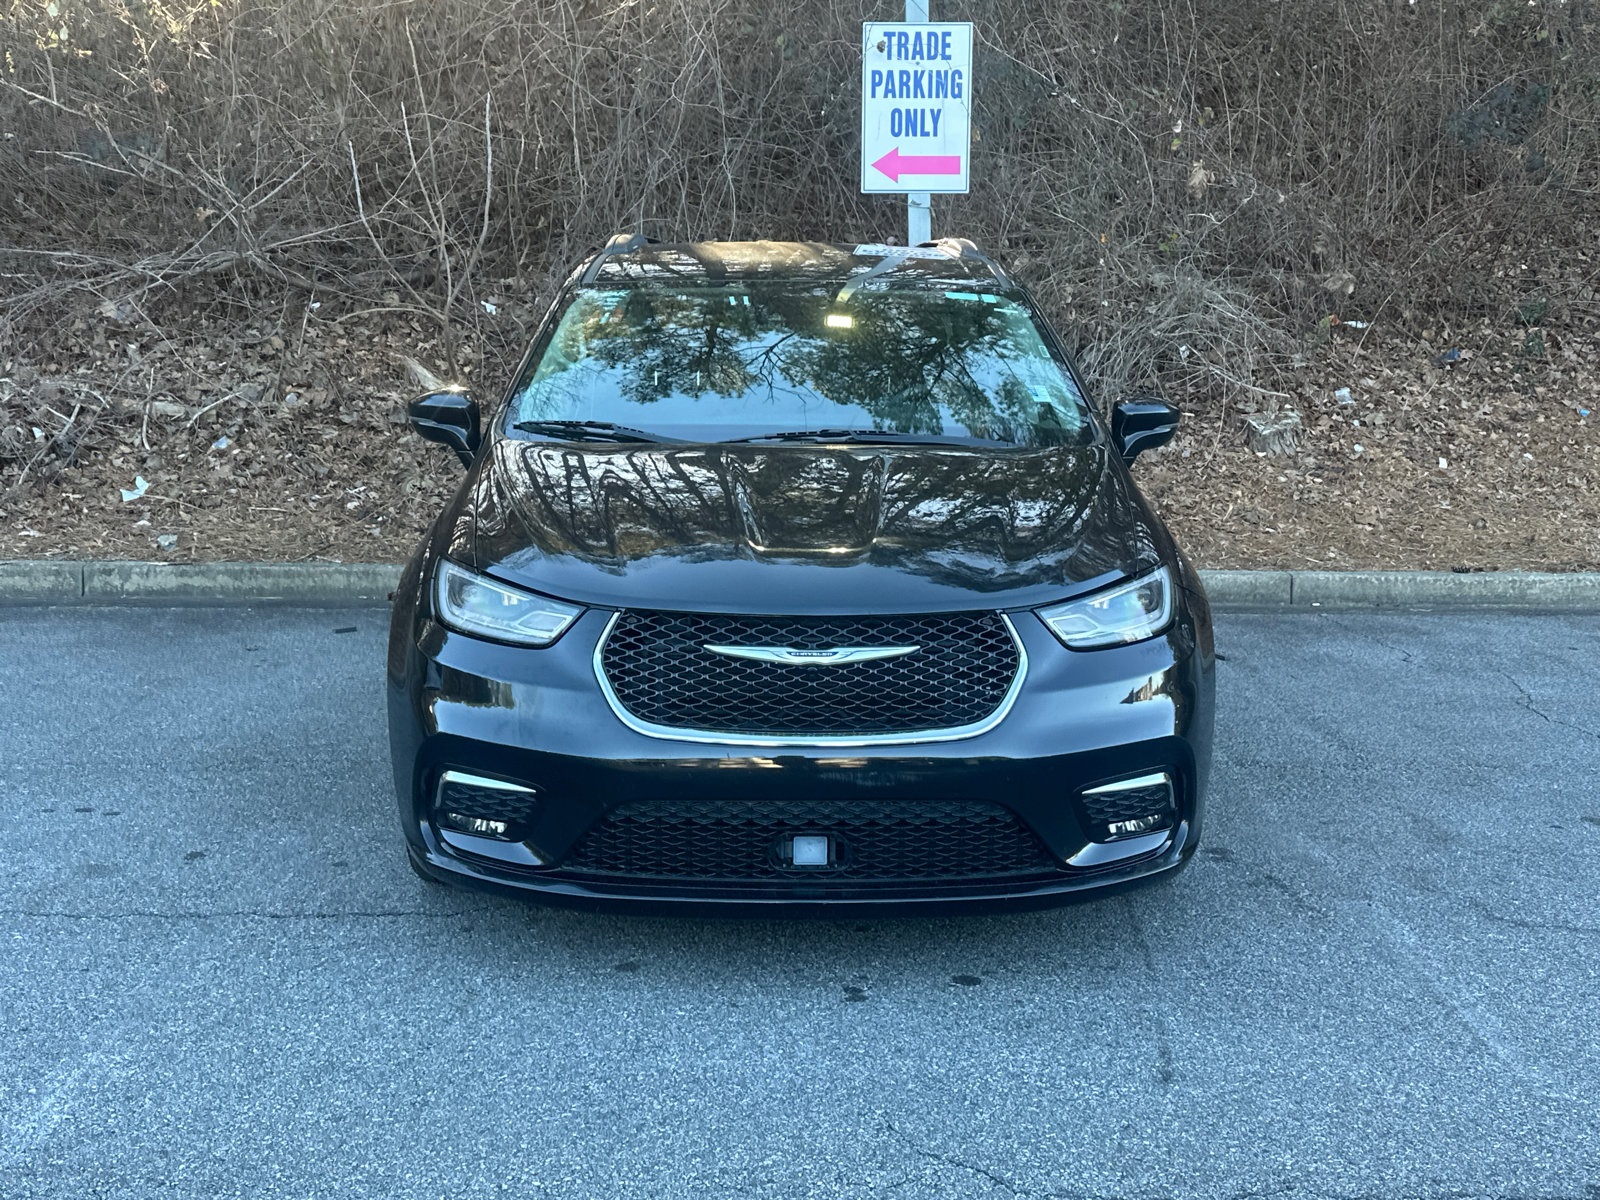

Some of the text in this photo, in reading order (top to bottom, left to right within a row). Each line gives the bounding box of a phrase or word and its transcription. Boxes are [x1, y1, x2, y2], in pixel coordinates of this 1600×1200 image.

[883, 31, 952, 60] TRADE
[871, 69, 963, 99] PARKING
[890, 107, 942, 138] ONLY
